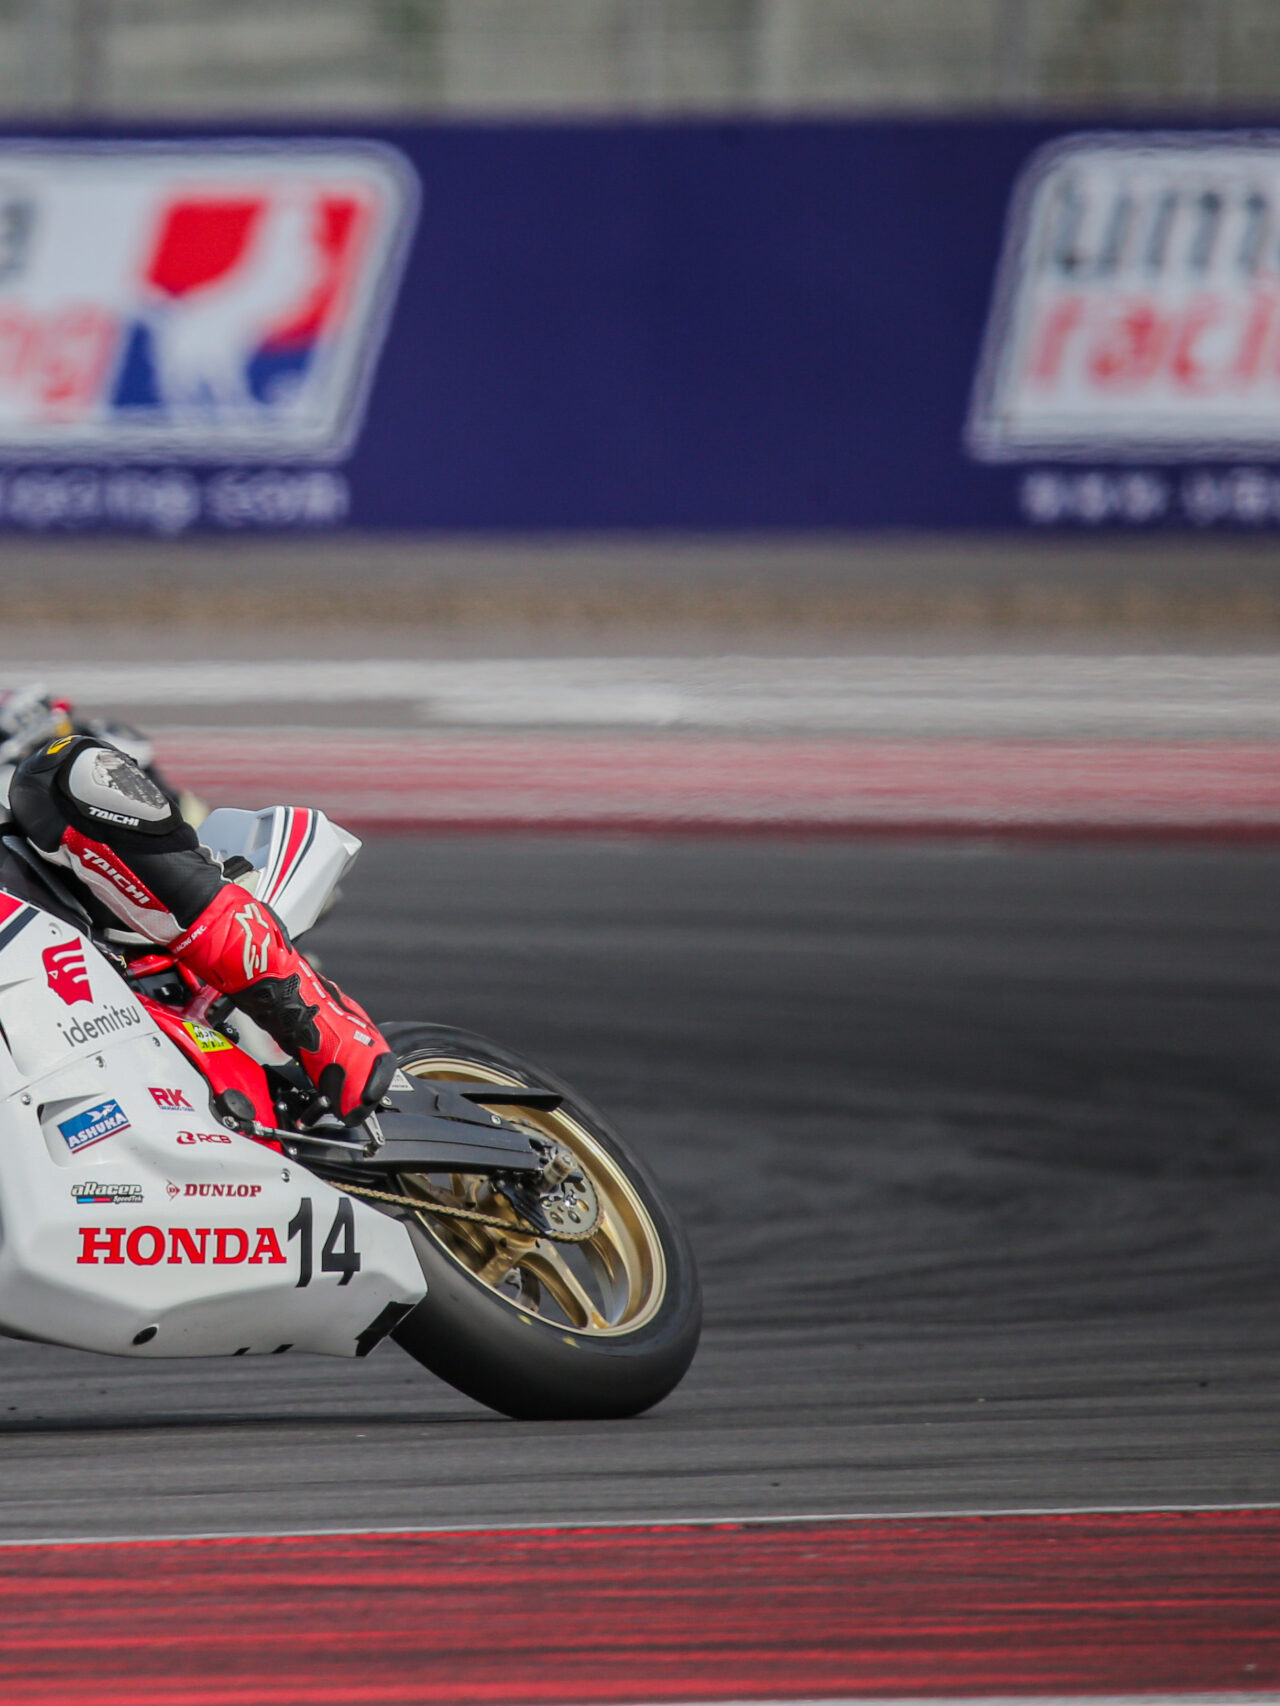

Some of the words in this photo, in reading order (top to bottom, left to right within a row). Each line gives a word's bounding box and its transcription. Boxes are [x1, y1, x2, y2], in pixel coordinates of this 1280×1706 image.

[88, 806, 140, 827] TAICHI
[82, 847, 151, 904] TAICHI
[56, 1004, 141, 1047] idemitsu
[147, 1087, 193, 1108] RK
[68, 1112, 128, 1148] ASHUKA
[196, 1133, 232, 1144] RCB
[71, 1182, 142, 1197] aRacer
[183, 1183, 262, 1198] DUNLOP
[77, 1226, 287, 1266] HONDA
[287, 1197, 361, 1288] 14
